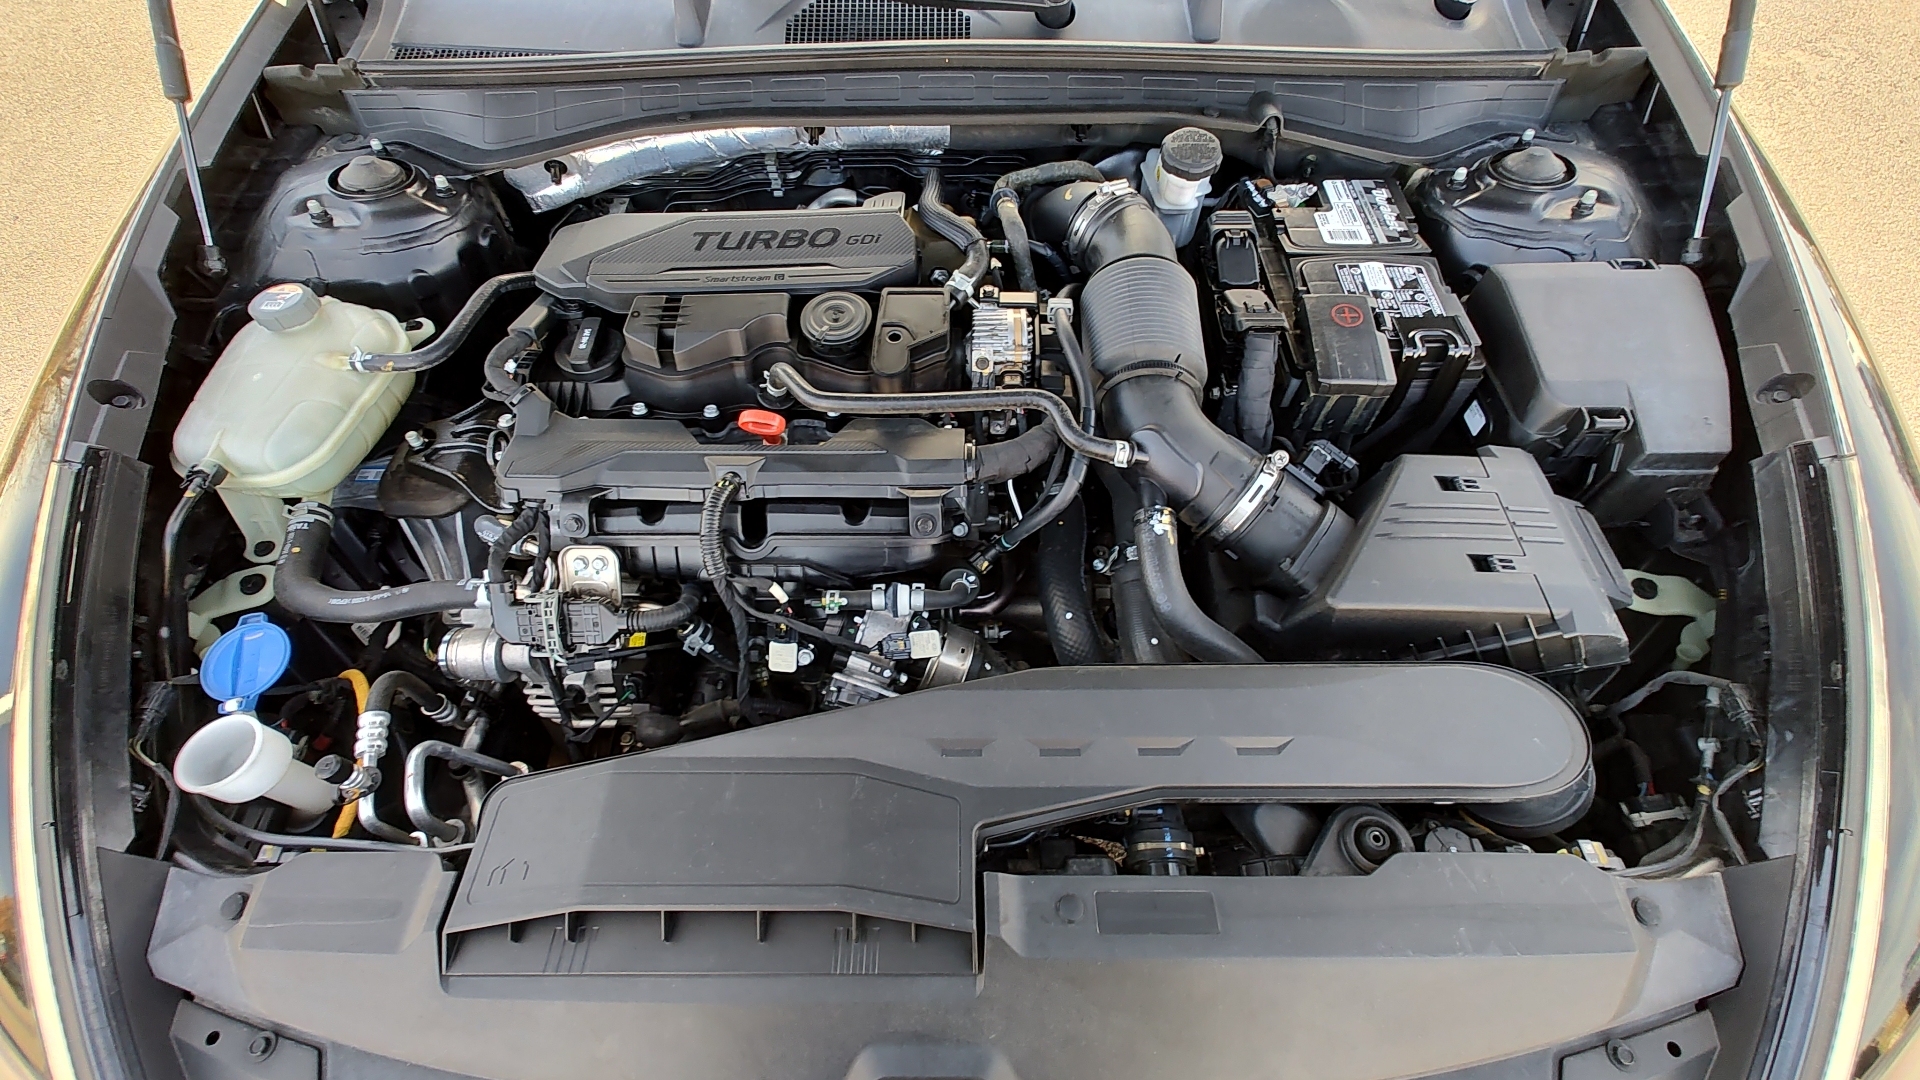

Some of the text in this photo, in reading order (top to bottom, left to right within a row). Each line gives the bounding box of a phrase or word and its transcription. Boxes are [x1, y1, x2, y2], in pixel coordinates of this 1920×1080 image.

[1371, 187, 1404, 232] Duralast
[693, 227, 882, 251] TURBO GDi
[703, 275, 772, 283] Smartstream
